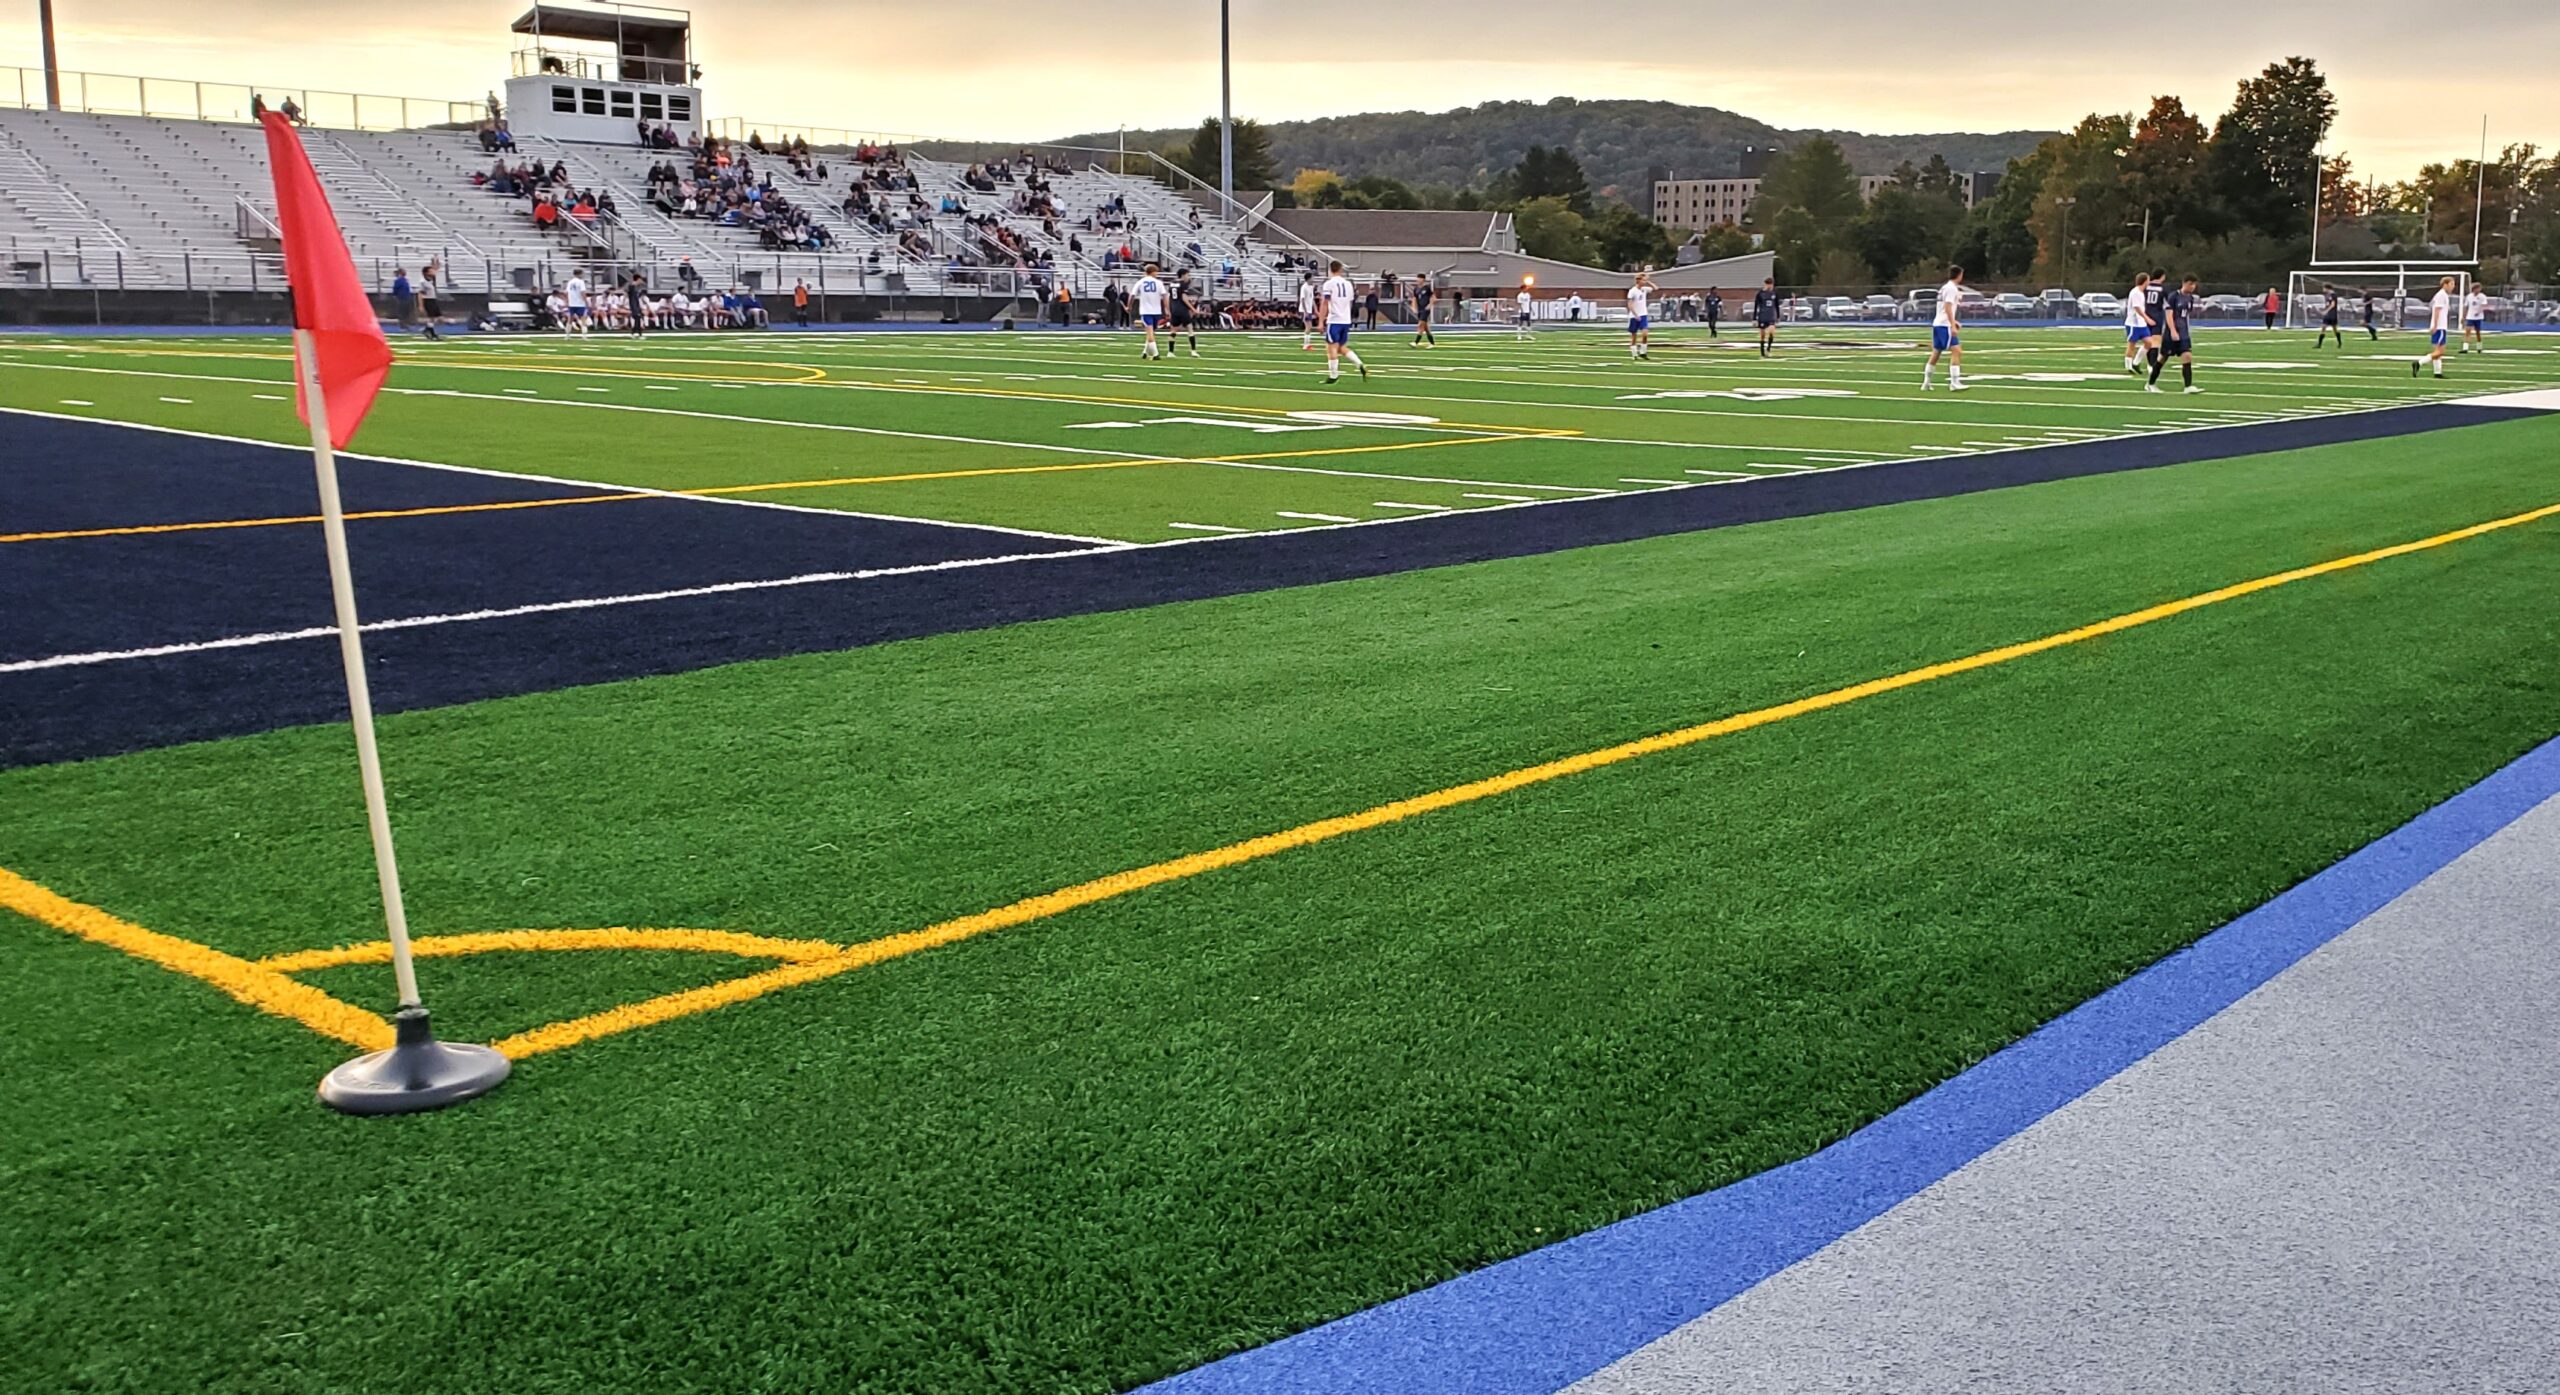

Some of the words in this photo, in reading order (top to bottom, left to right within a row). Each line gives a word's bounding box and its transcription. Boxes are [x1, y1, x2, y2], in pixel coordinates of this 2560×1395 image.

[1143, 281, 1157, 293] 20
[1336, 283, 1347, 297] 11
[2146, 291, 2159, 304] 10
